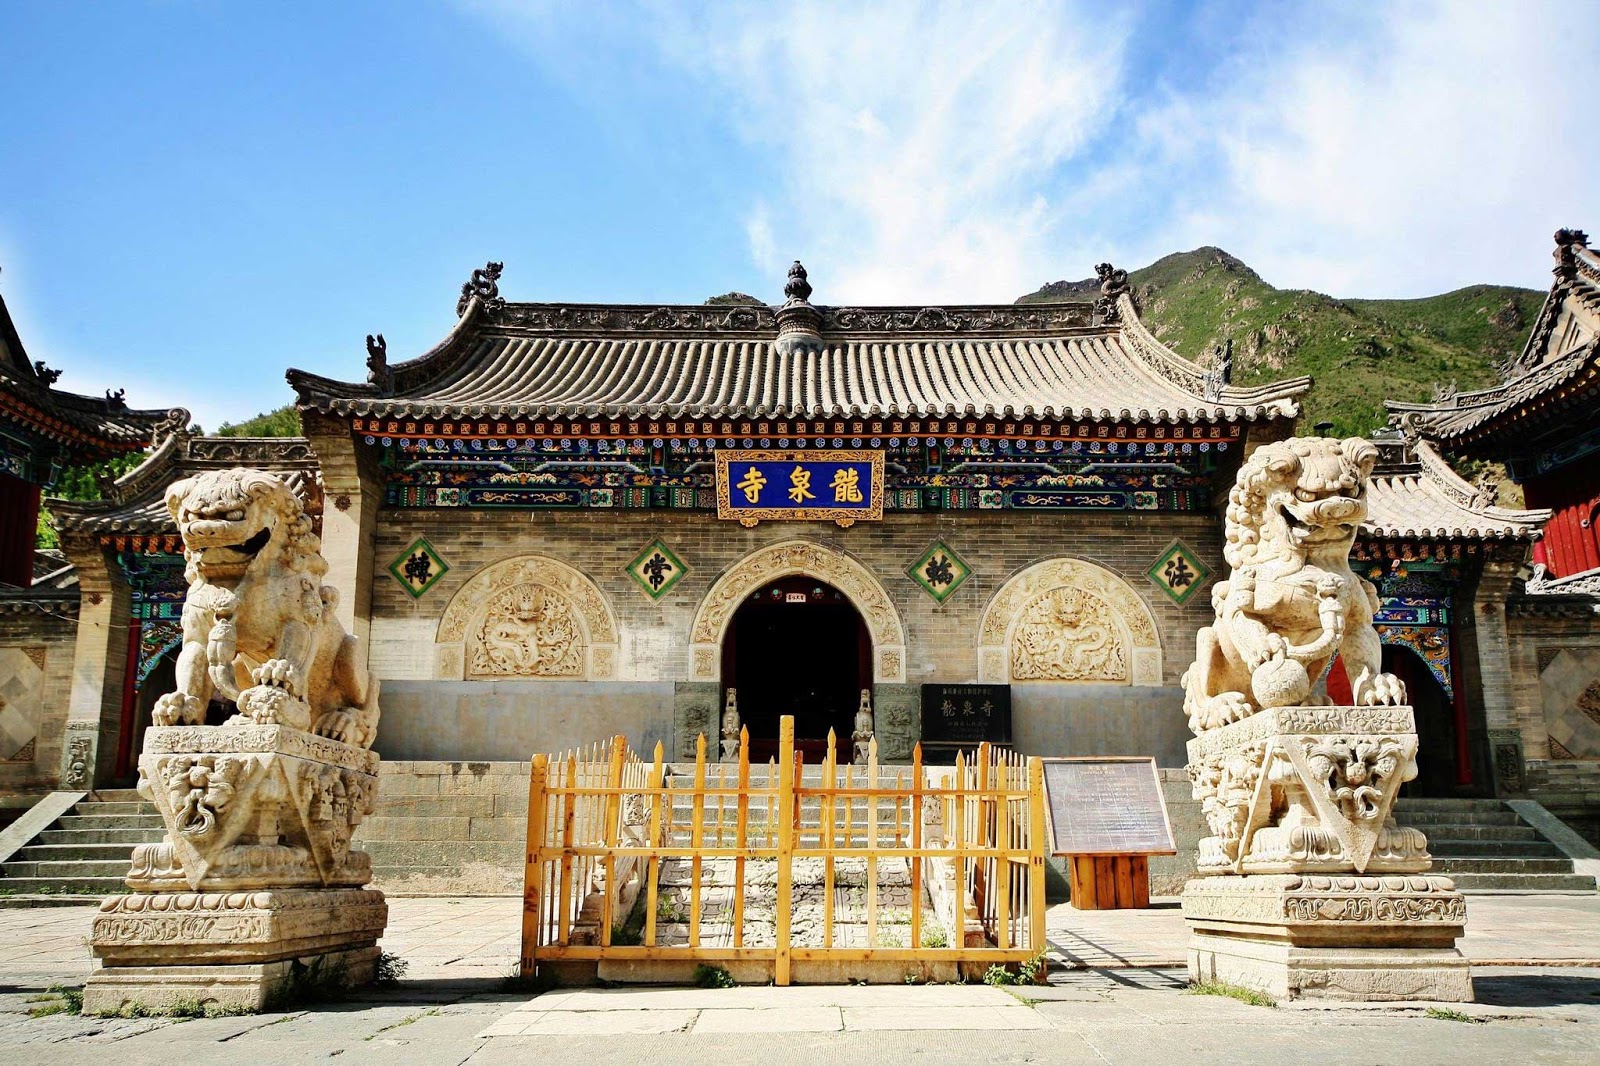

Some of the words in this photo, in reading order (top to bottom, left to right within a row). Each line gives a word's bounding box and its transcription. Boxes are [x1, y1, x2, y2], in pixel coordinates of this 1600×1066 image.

[405, 551, 432, 585] 轉
[643, 553, 672, 590] 常
[926, 554, 953, 587] 輪
[1165, 556, 1194, 588] 法
